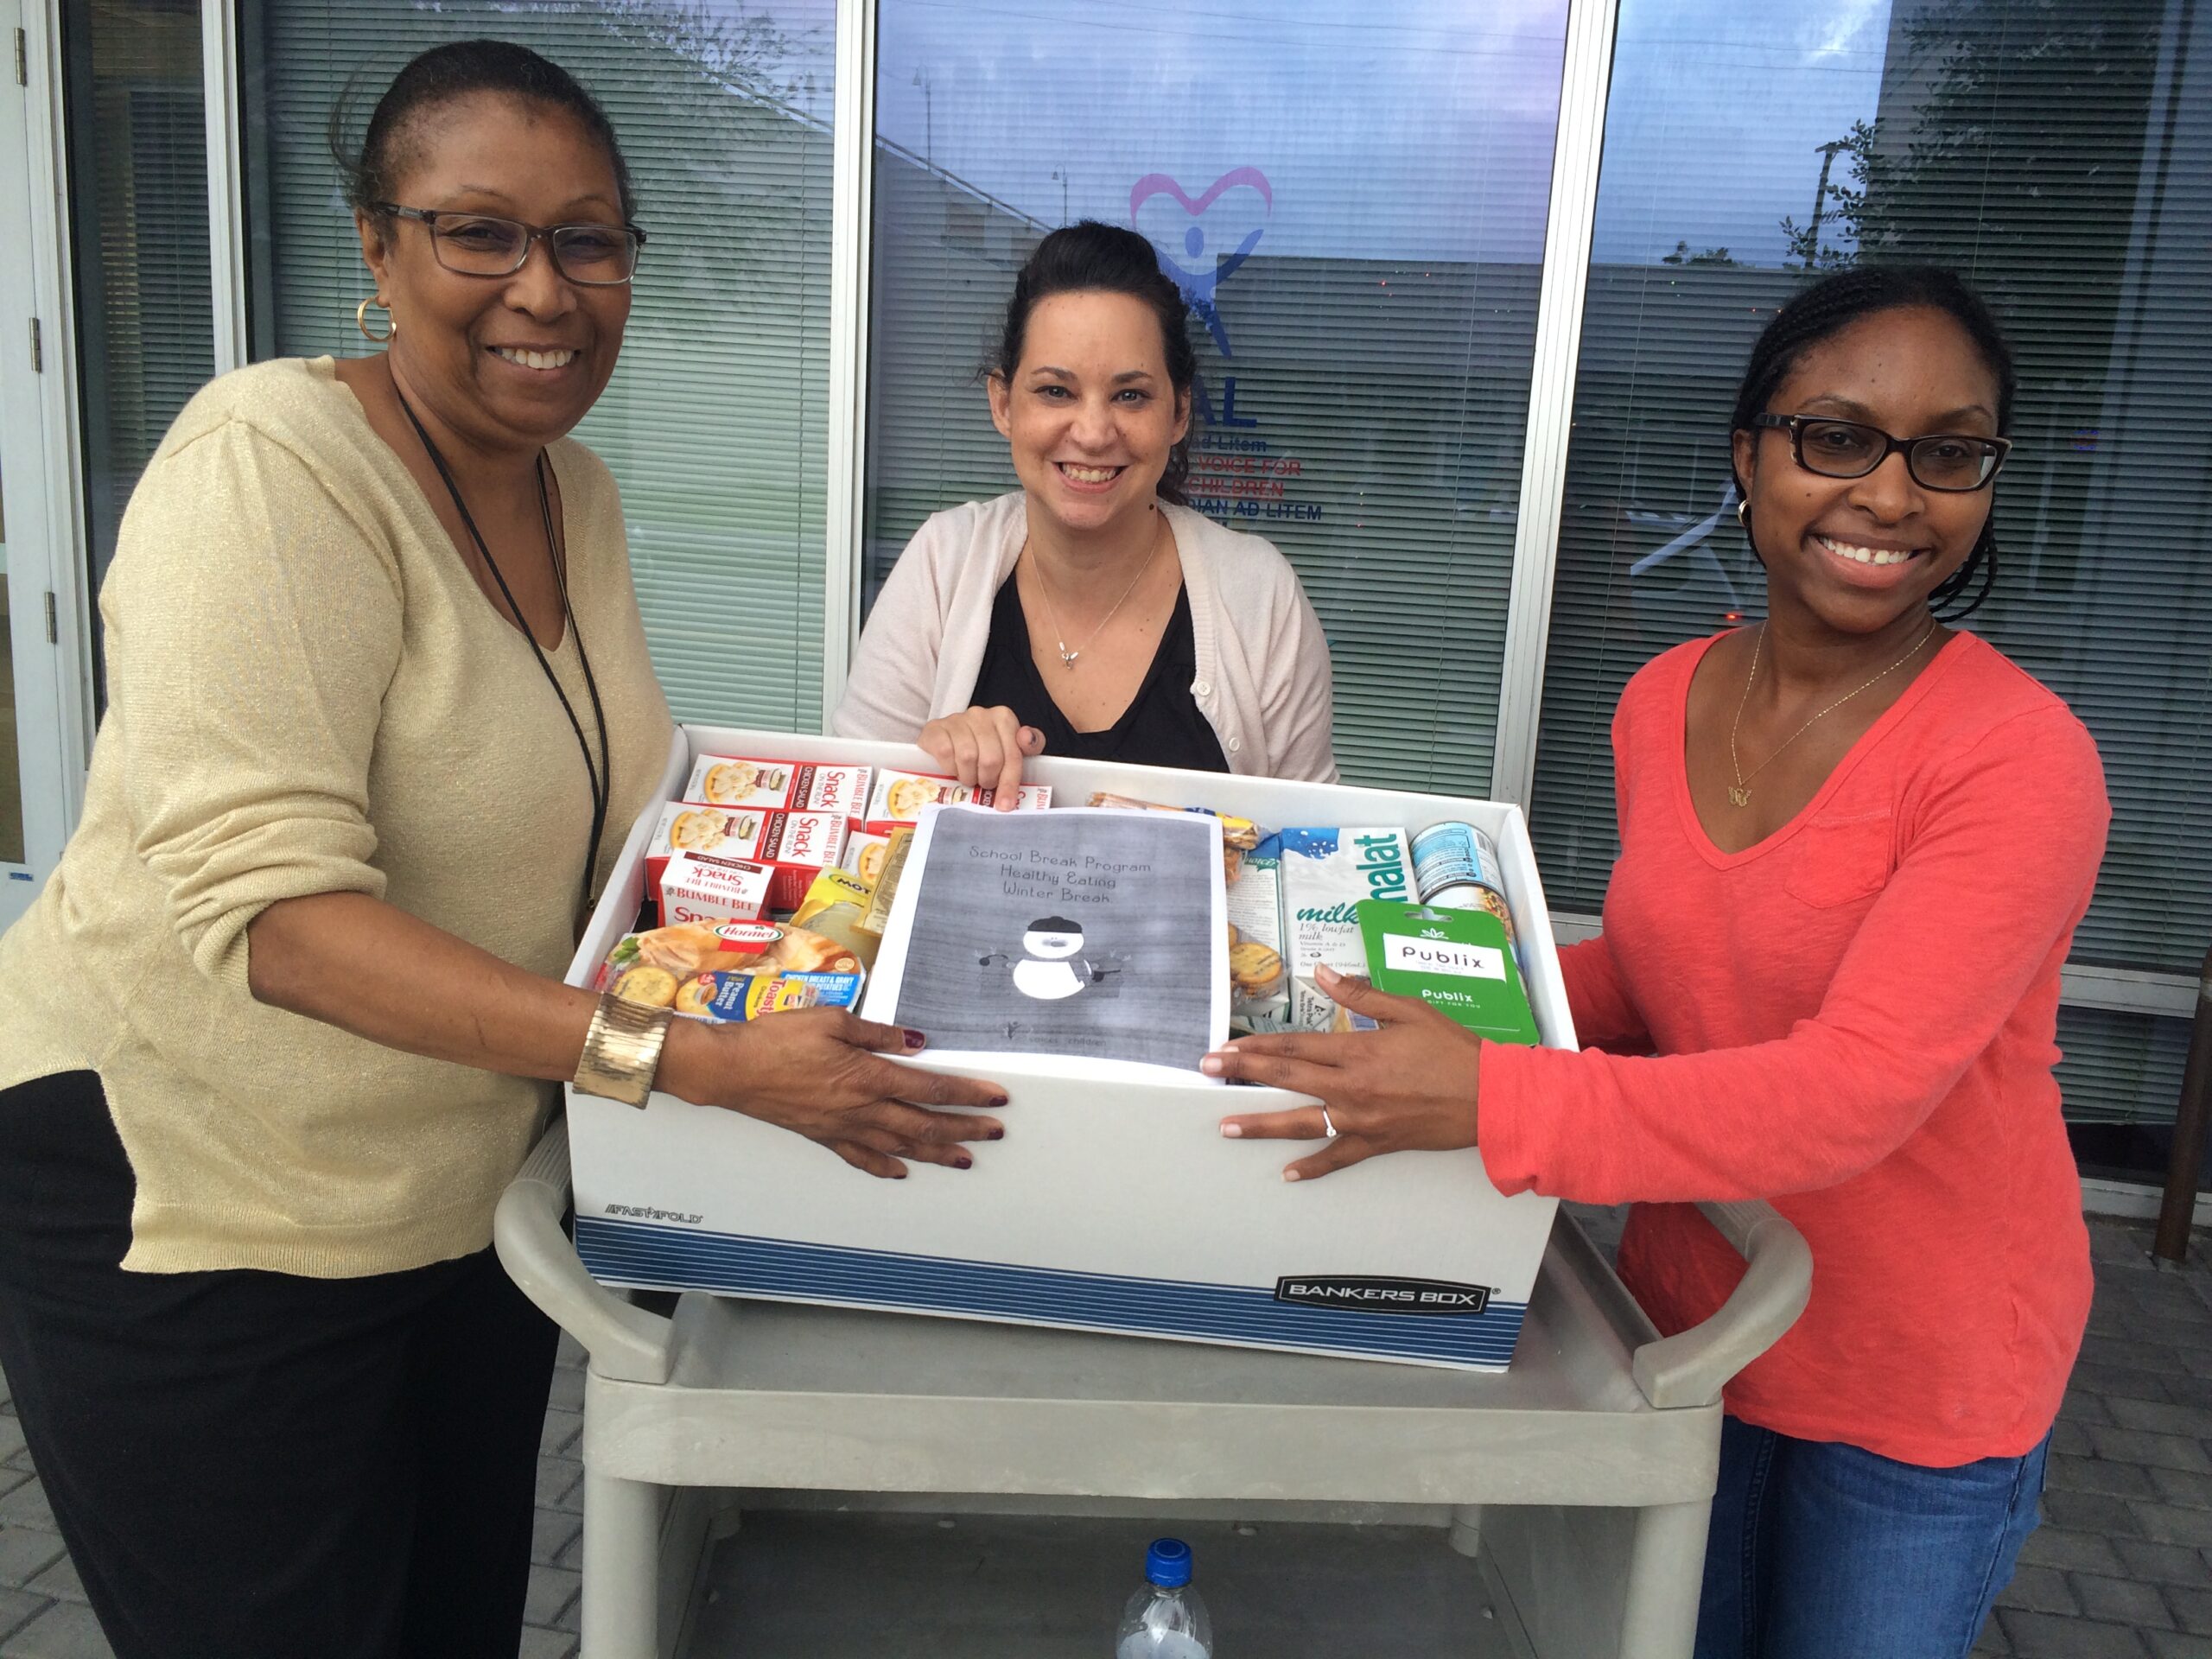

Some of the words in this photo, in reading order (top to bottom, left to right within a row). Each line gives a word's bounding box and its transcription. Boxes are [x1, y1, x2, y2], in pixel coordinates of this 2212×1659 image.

[1218, 436, 1267, 452] Litem
[1198, 455, 1255, 474] VOICE
[1262, 459, 1301, 475] FOR
[1189, 476, 1285, 497] CHILDREN
[1233, 502, 1260, 517] AD
[1266, 503, 1322, 520] LITEM
[801, 766, 813, 790] CHICKEN
[820, 770, 846, 808] Snack
[796, 789, 809, 808] SALAD
[771, 813, 785, 837] CHICKEN
[766, 837, 779, 858] SALAD
[791, 817, 819, 857] Snack
[697, 855, 721, 865] SALAD
[721, 859, 751, 871] CHICKEN
[969, 845, 1022, 862] School
[1030, 849, 1077, 868] Break
[1085, 855, 1152, 874] Program
[692, 866, 744, 886] Snack
[1000, 863, 1059, 885] Healthy
[1066, 870, 1116, 889] Eating
[677, 887, 727, 906] BUMBLE
[732, 899, 753, 911] BEE
[1002, 880, 1053, 899] Winter
[1061, 888, 1110, 904] Break
[1296, 901, 1359, 925] milk
[723, 926, 775, 938] Hormel
[1299, 931, 1323, 941] milk
[1300, 923, 1319, 931] 1%
[1321, 923, 1355, 935] lowfat
[1402, 946, 1484, 969] Publix
[715, 981, 734, 1007] Butter
[722, 982, 744, 1010] Peanut
[1421, 988, 1473, 1002] Publix
[1288, 1283, 1415, 1302] BANKERS
[1419, 1291, 1477, 1306] BOX
